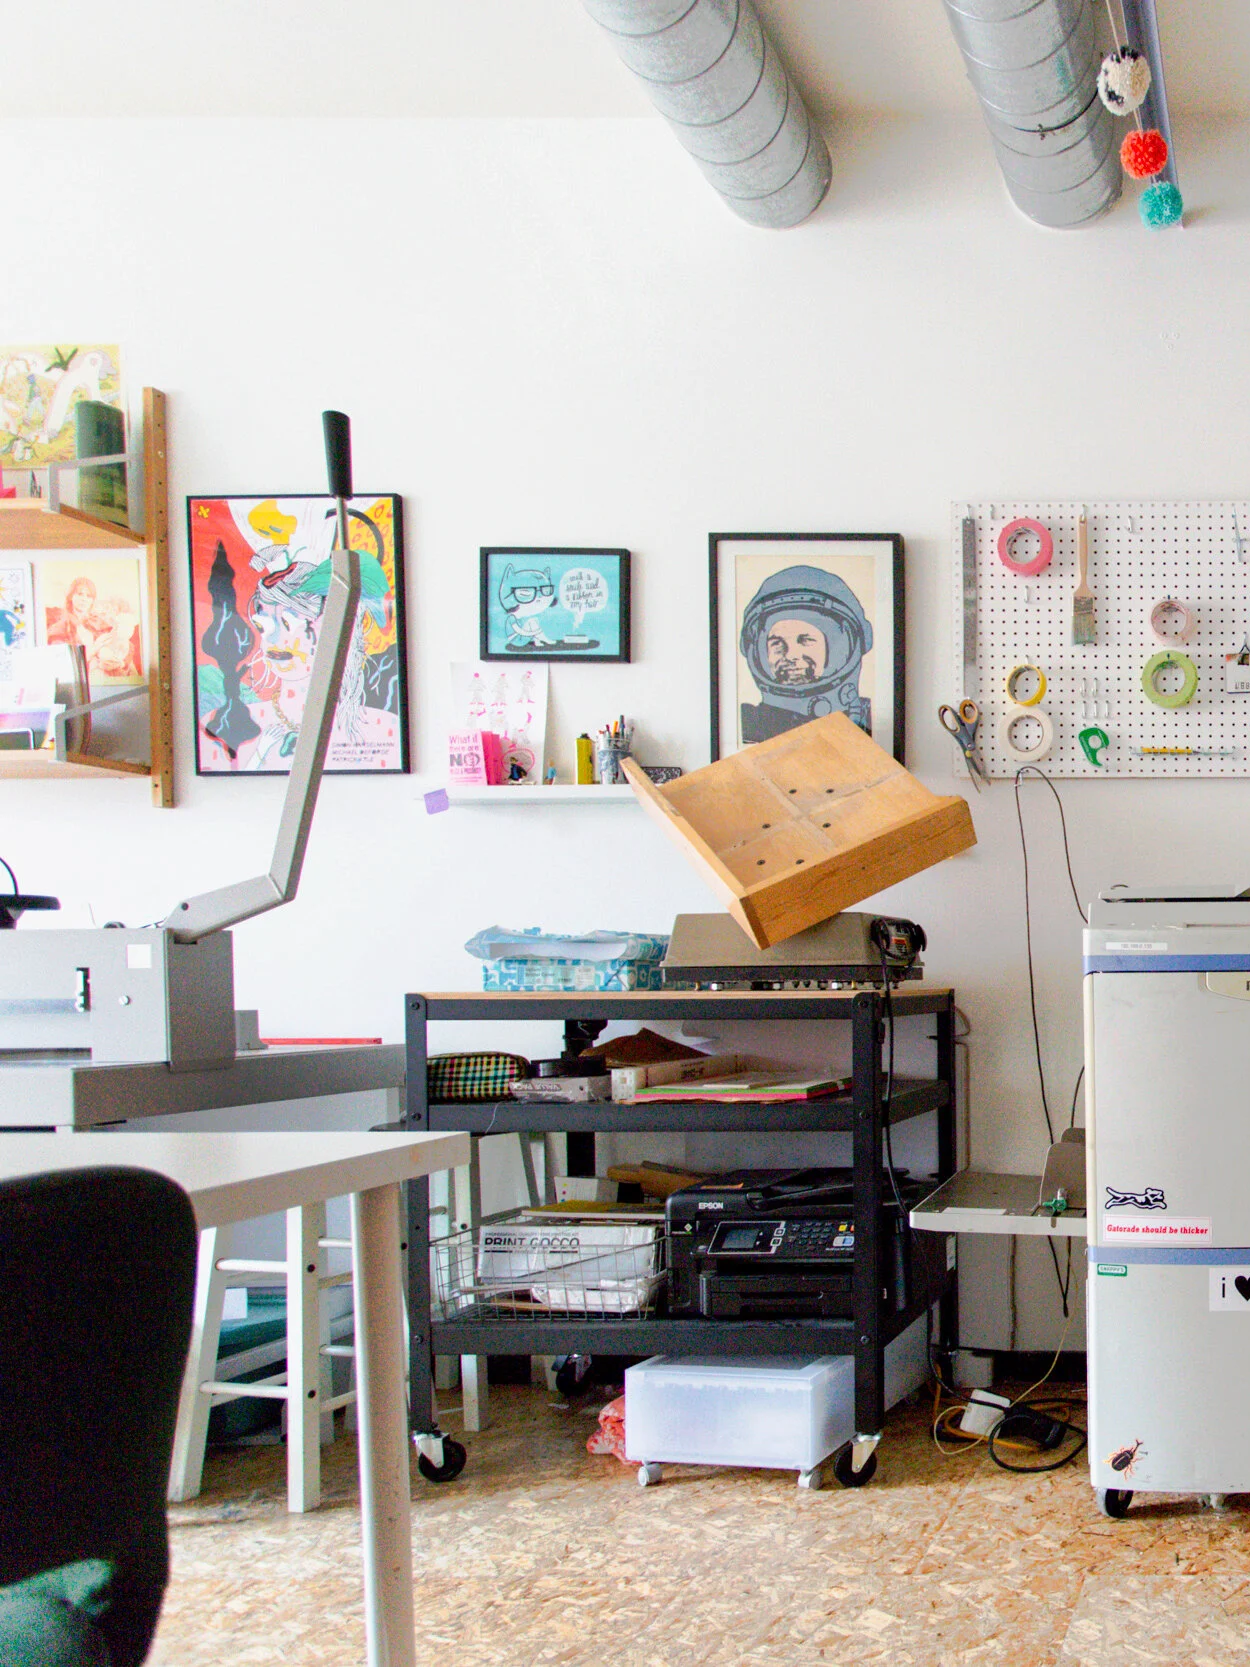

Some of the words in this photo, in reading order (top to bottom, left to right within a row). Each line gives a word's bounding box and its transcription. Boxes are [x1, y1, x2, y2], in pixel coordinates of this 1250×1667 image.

[1107, 1224, 1140, 1233] Gatorade
[1142, 1226, 1167, 1234] should
[1169, 1226, 1178, 1234] be
[1180, 1227, 1208, 1235] thicker
[484, 1237, 527, 1249] PRINT
[530, 1237, 580, 1249] GOCCO
[1222, 1277, 1226, 1298] i
